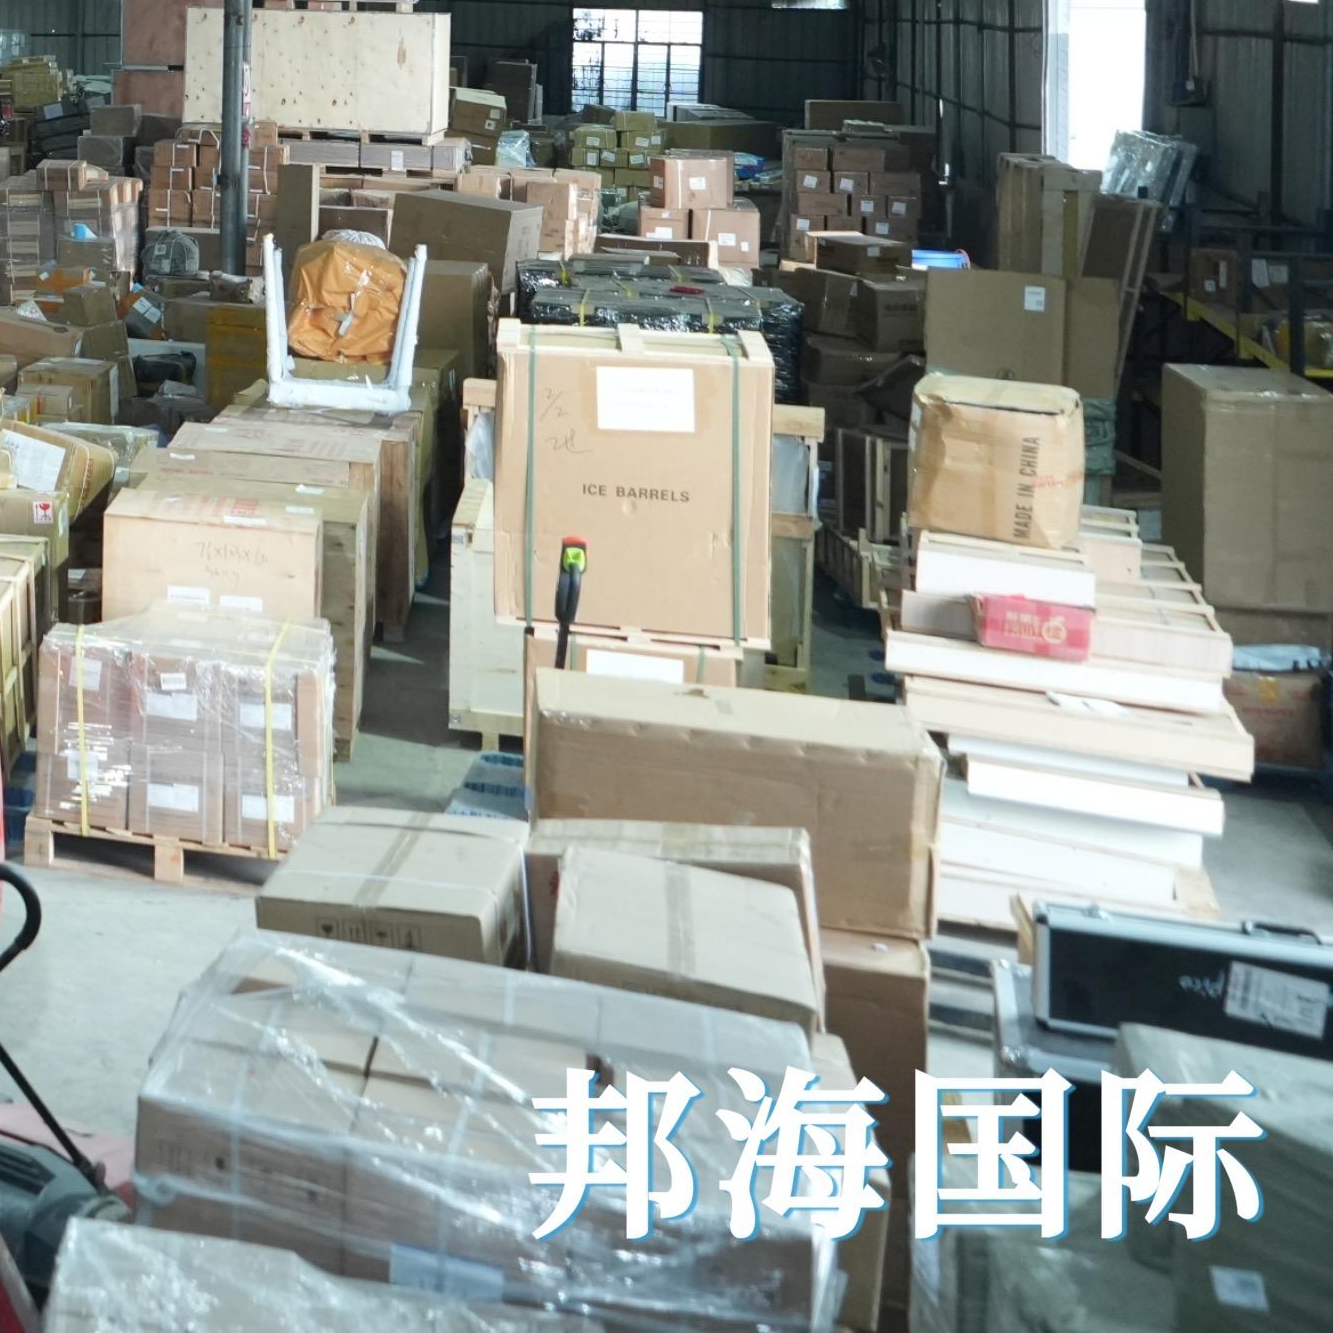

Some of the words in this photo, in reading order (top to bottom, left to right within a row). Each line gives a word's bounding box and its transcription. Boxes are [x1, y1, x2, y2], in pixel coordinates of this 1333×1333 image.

[1018, 436, 1040, 477] CHINA
[582, 482, 607, 497] ICE
[615, 485, 691, 503] BARRELS
[1015, 482, 1036, 499] IN
[1012, 504, 1034, 540] MADE
